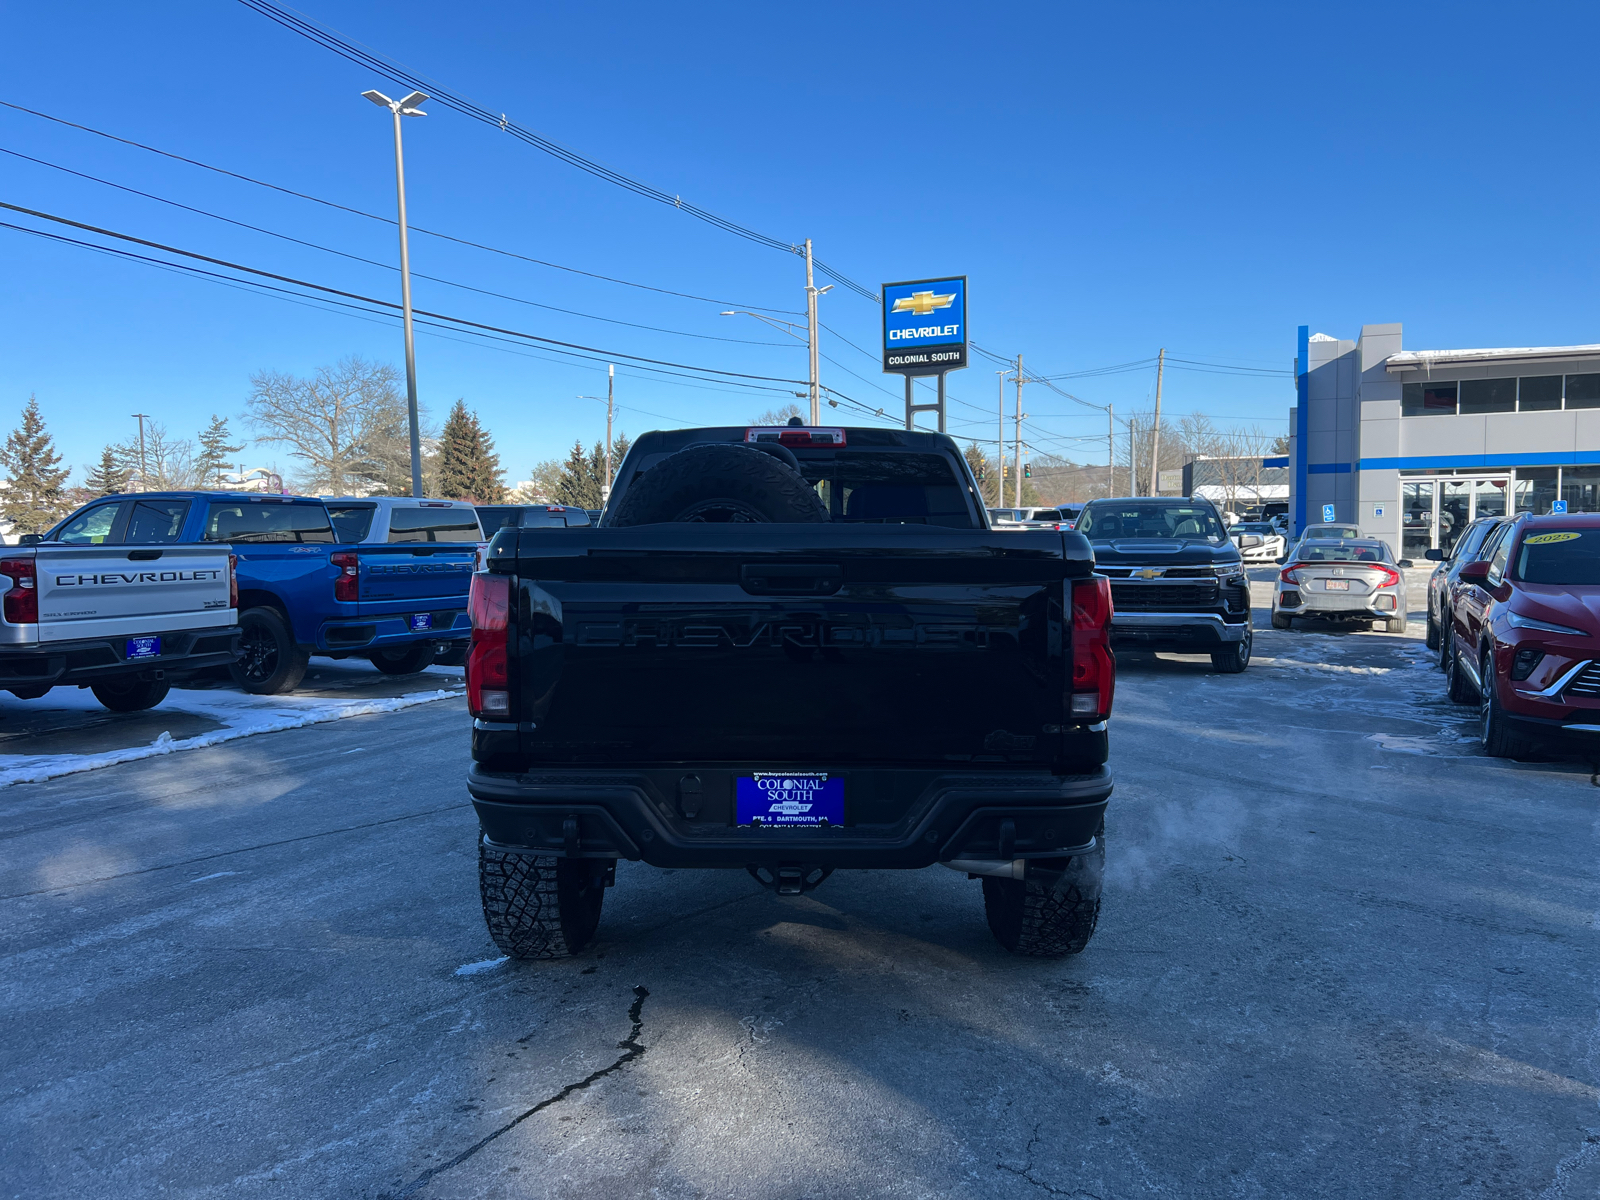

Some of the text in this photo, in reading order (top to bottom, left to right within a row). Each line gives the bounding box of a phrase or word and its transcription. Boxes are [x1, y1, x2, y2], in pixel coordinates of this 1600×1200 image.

[889, 325, 959, 340] CHEVROLET
[888, 352, 960, 365] COLONIAL SOUTH
[1534, 534, 1570, 543] 2025
[369, 564, 474, 575] CHEVROLET
[56, 570, 221, 586] CHEVROLET
[575, 621, 1008, 647] CHEVROLET
[757, 779, 824, 790] COLONIAL
[767, 790, 813, 800] SOUTH
